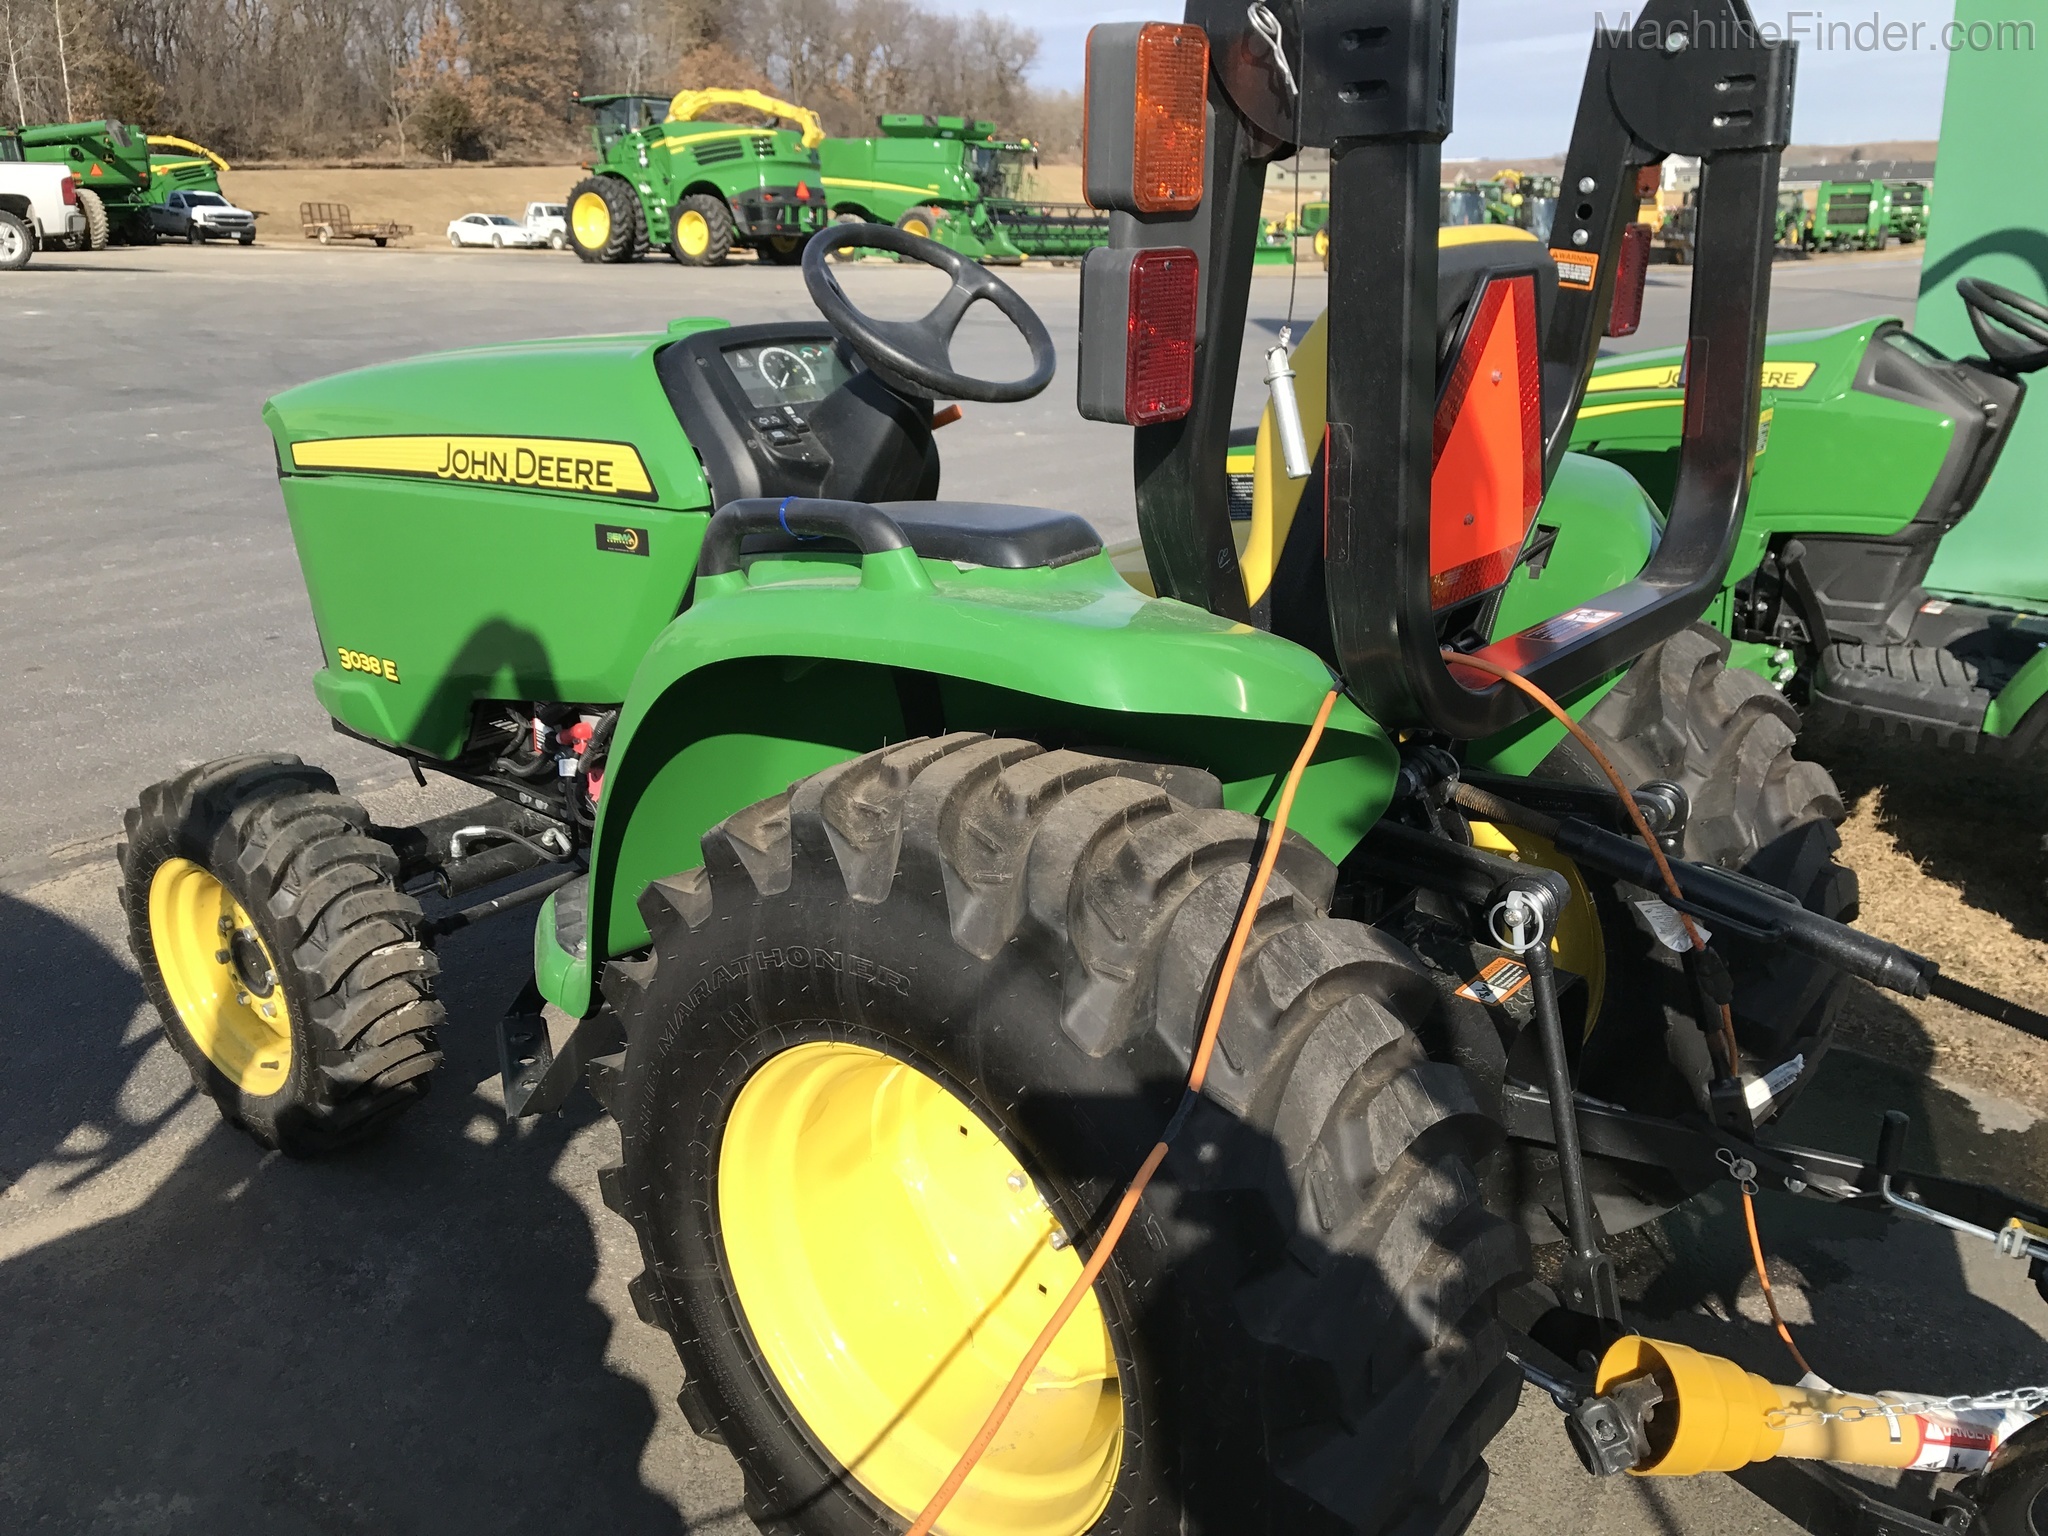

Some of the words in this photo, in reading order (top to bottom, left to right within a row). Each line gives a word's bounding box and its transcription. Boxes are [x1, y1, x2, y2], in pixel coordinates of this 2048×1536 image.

[437, 442, 508, 474] JOHN
[515, 447, 614, 488] DEERE
[337, 646, 383, 677] 3038
[657, 945, 911, 1057] MARATHONER
